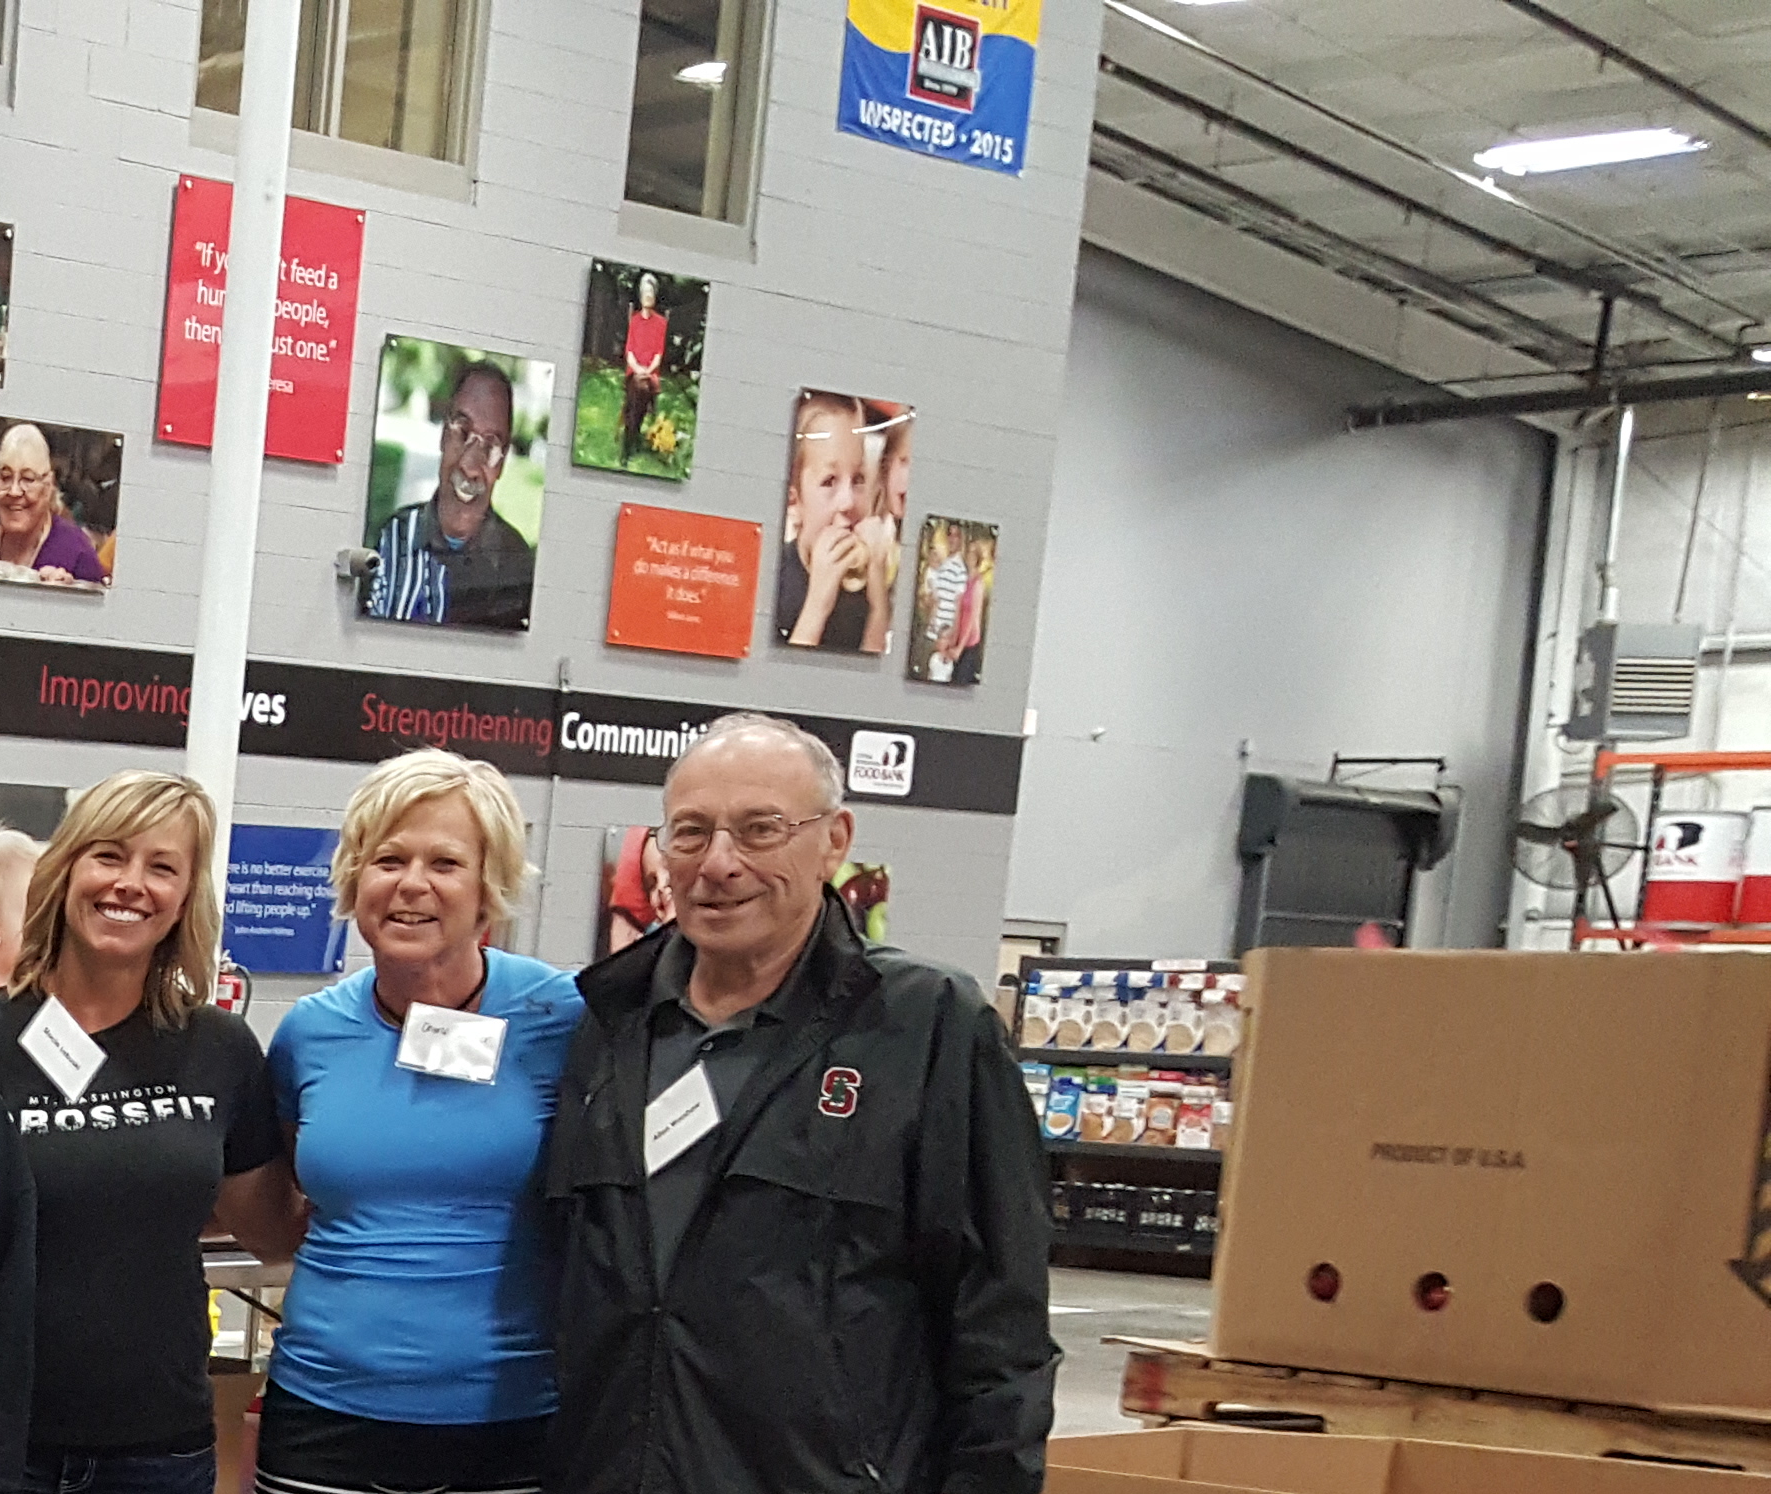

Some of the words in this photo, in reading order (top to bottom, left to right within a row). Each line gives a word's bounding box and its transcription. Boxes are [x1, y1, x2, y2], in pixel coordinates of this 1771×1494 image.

[919, 20, 974, 70] AIB
[859, 98, 956, 149] INSPECTED
[969, 130, 1015, 165] 2015
[290, 257, 326, 288] feed
[327, 271, 339, 290] a
[184, 314, 223, 345] then
[271, 334, 293, 356] ust
[239, 690, 287, 725] ves
[360, 693, 554, 757] Strengthening
[250, 863, 263, 876] no
[252, 881, 273, 895] than
[274, 883, 314, 901] reaching
[264, 902, 296, 919] people
[8, 1095, 216, 1136] ROSSFIT
